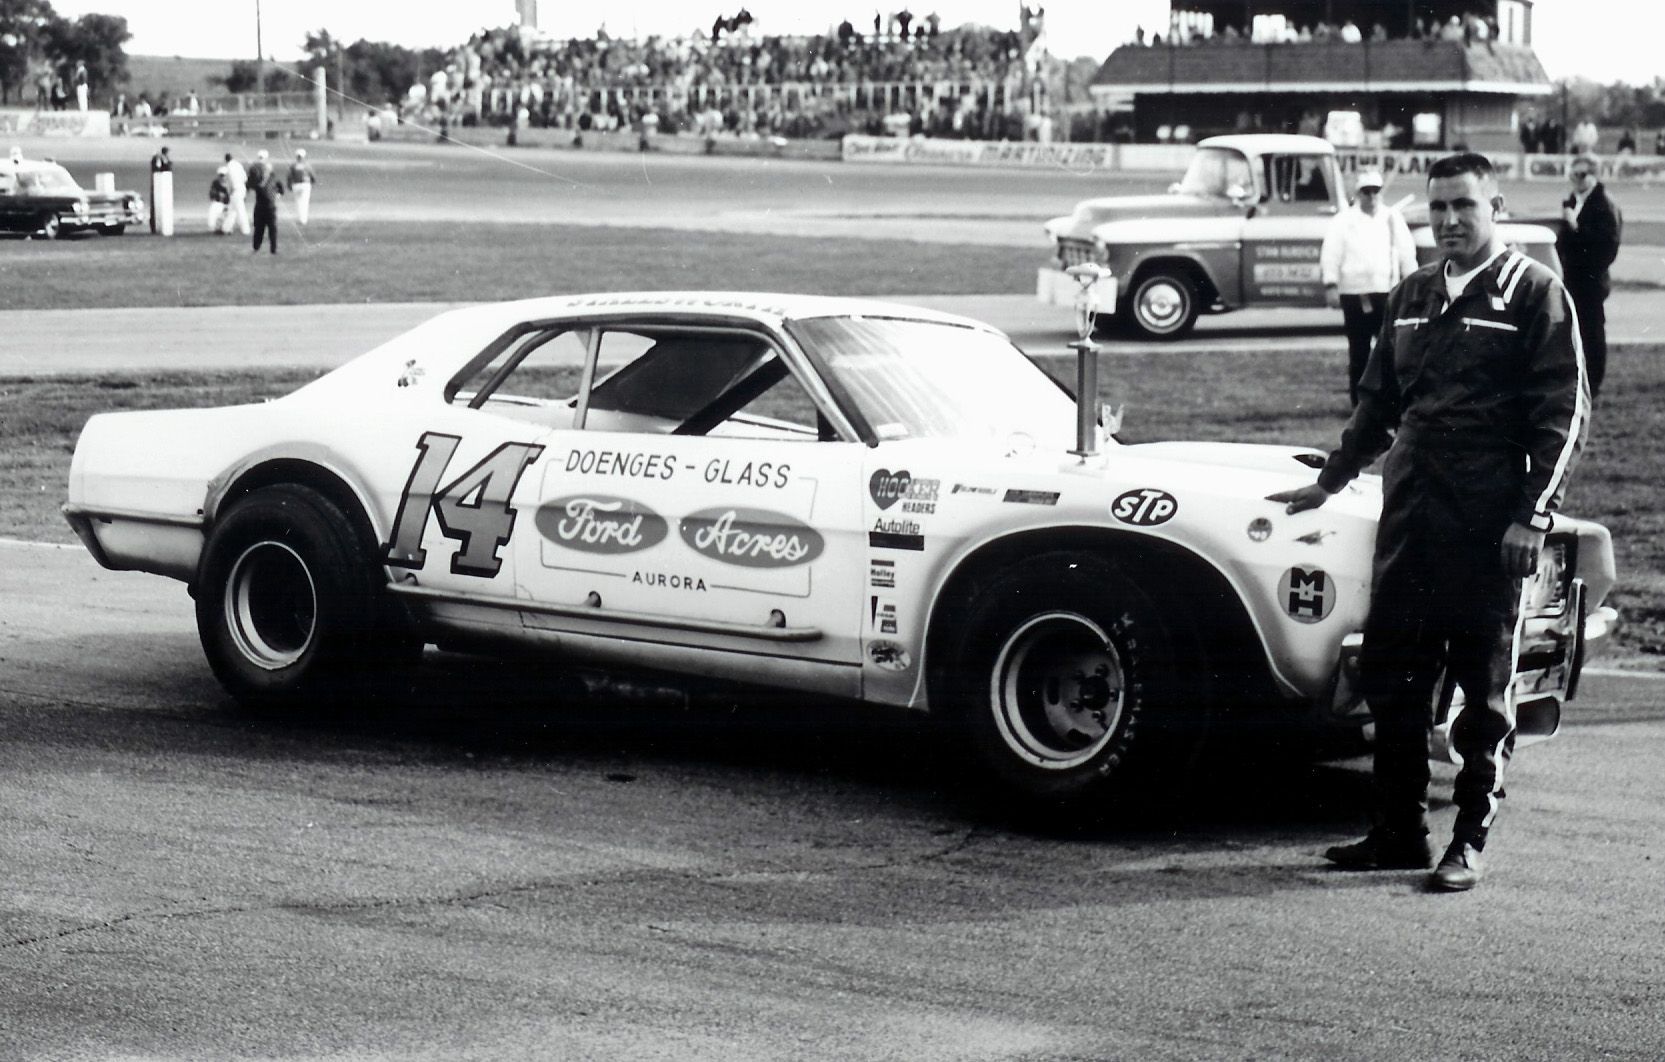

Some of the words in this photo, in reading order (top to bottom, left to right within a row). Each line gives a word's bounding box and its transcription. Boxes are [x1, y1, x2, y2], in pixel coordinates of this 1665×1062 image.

[565, 449, 677, 480] DOENGES
[704, 459, 791, 489] GLASS
[877, 476, 940, 501] HOOKER
[380, 431, 546, 579] 14
[902, 502, 936, 515] HEADERS
[1114, 489, 1174, 523] STP
[558, 499, 645, 546] Ford
[695, 511, 809, 561] Acres
[874, 518, 920, 536] Autolite
[632, 571, 707, 592] AURORA
[870, 568, 895, 580] Holley
